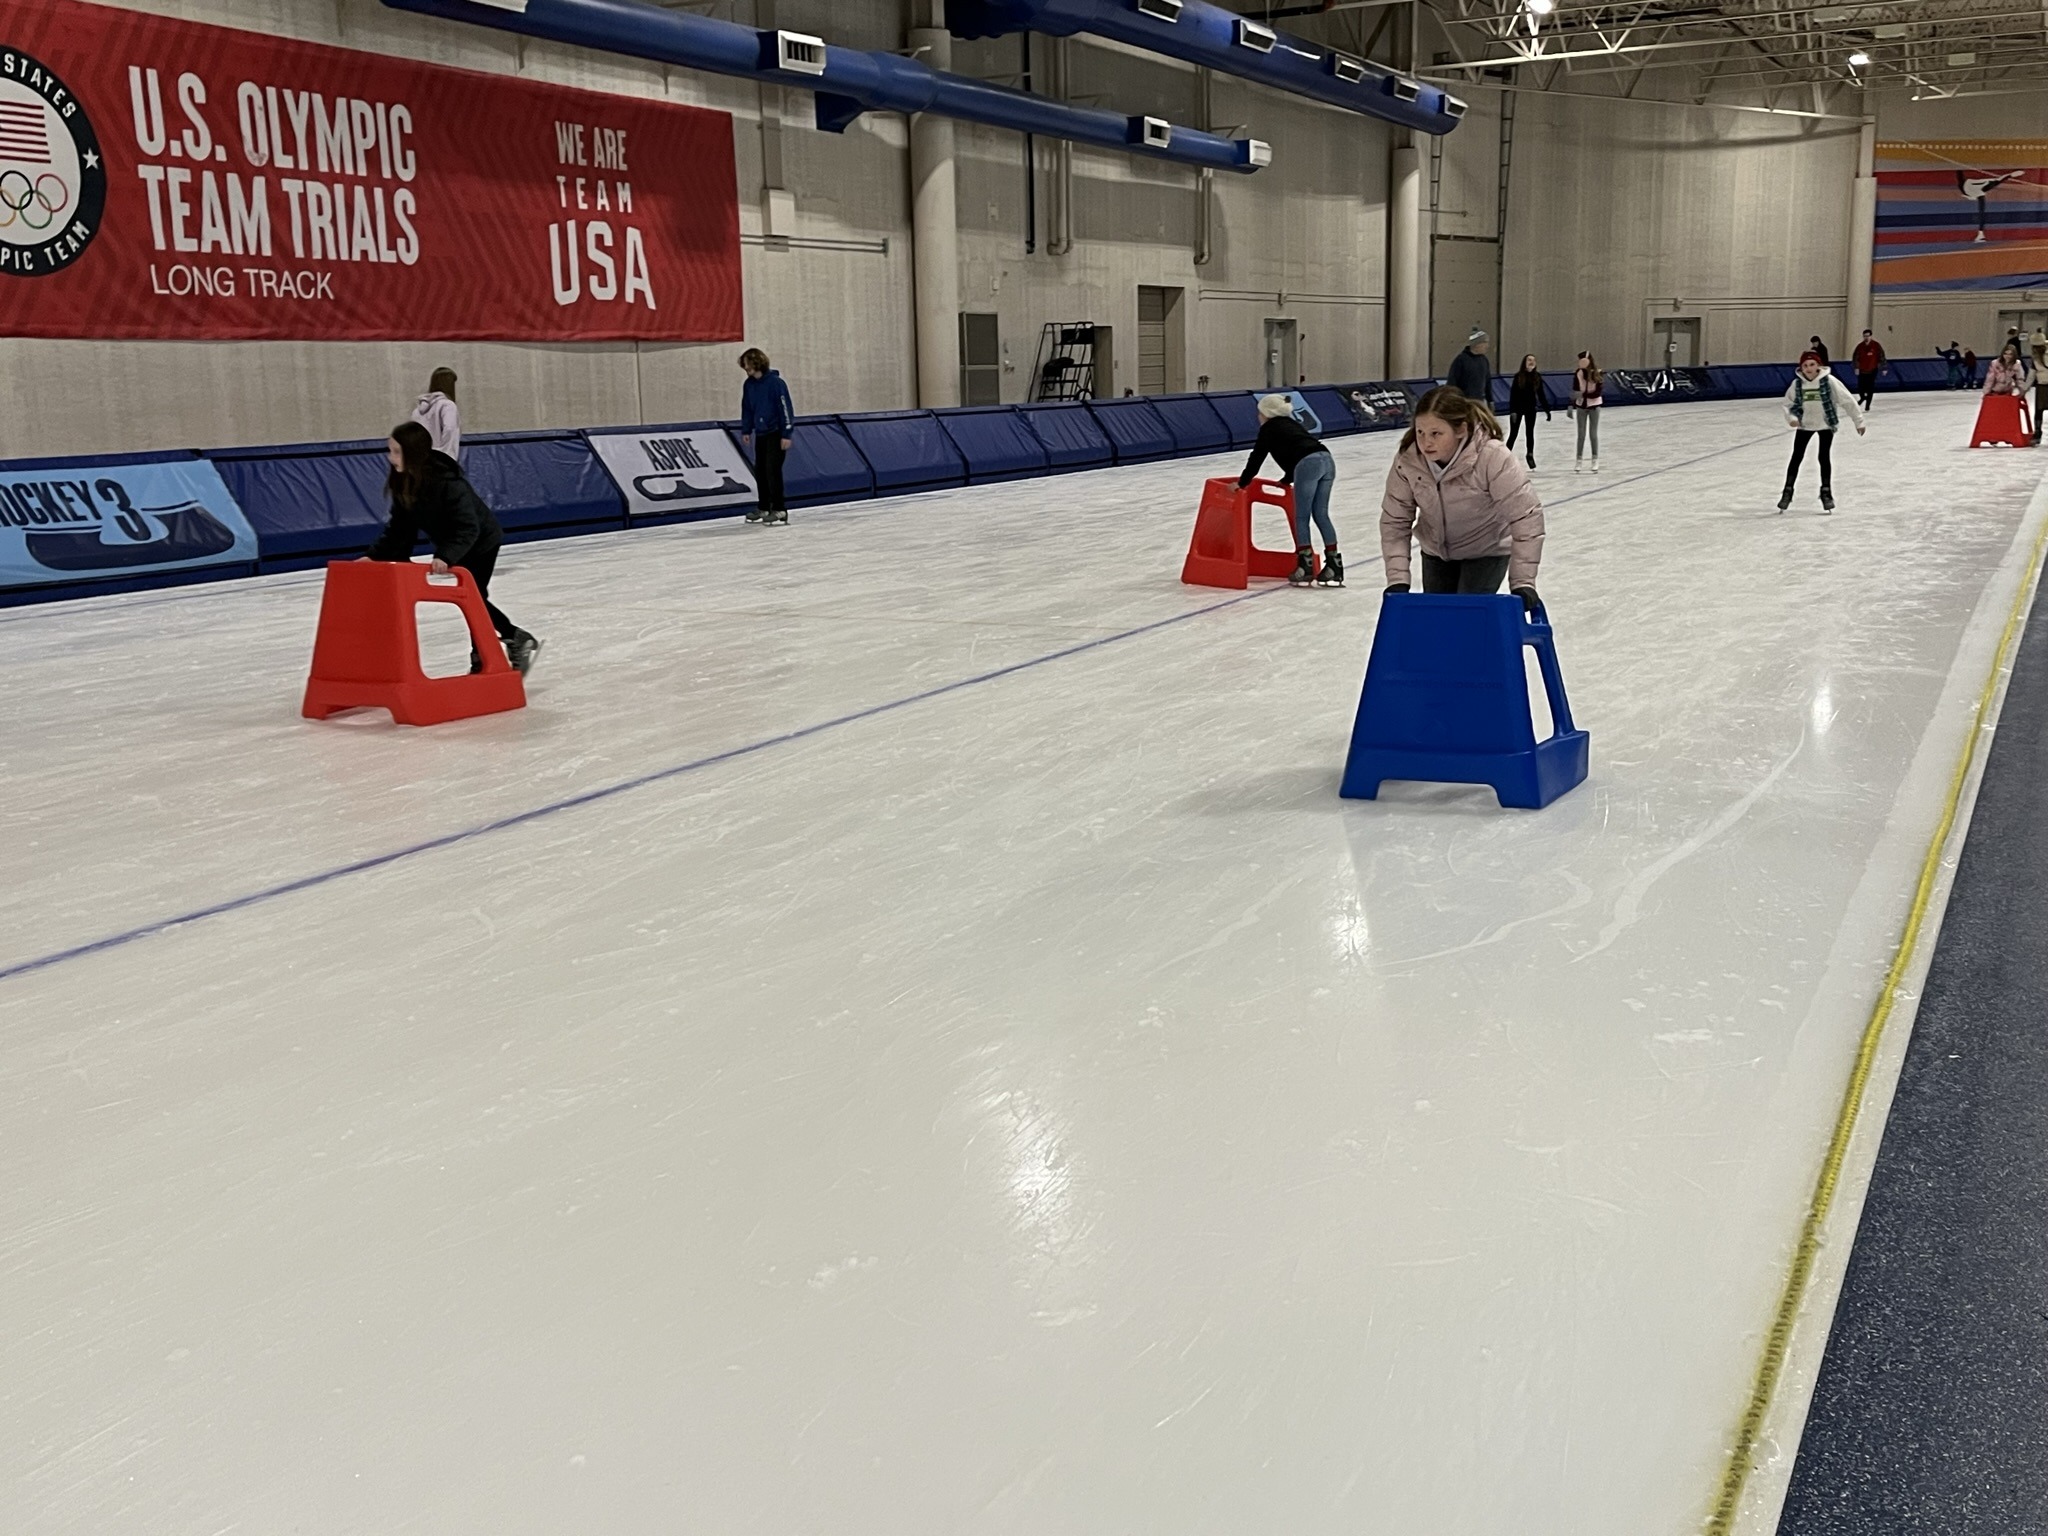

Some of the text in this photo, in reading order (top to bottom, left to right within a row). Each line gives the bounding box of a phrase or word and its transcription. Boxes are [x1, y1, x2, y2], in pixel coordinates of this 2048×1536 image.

[4, 53, 77, 118] STATES
[128, 65, 416, 182] U.S. OLYMPIC
[555, 121, 628, 171] WE ARE
[138, 164, 419, 266] TEAM TRIALS
[556, 175, 632, 213] TEAM
[43, 220, 90, 266] TEAM
[549, 219, 657, 310] USA
[150, 264, 334, 300] LONG TRACK
[639, 437, 709, 471] ASPIRE
[0, 478, 151, 541] OCKEY 3
